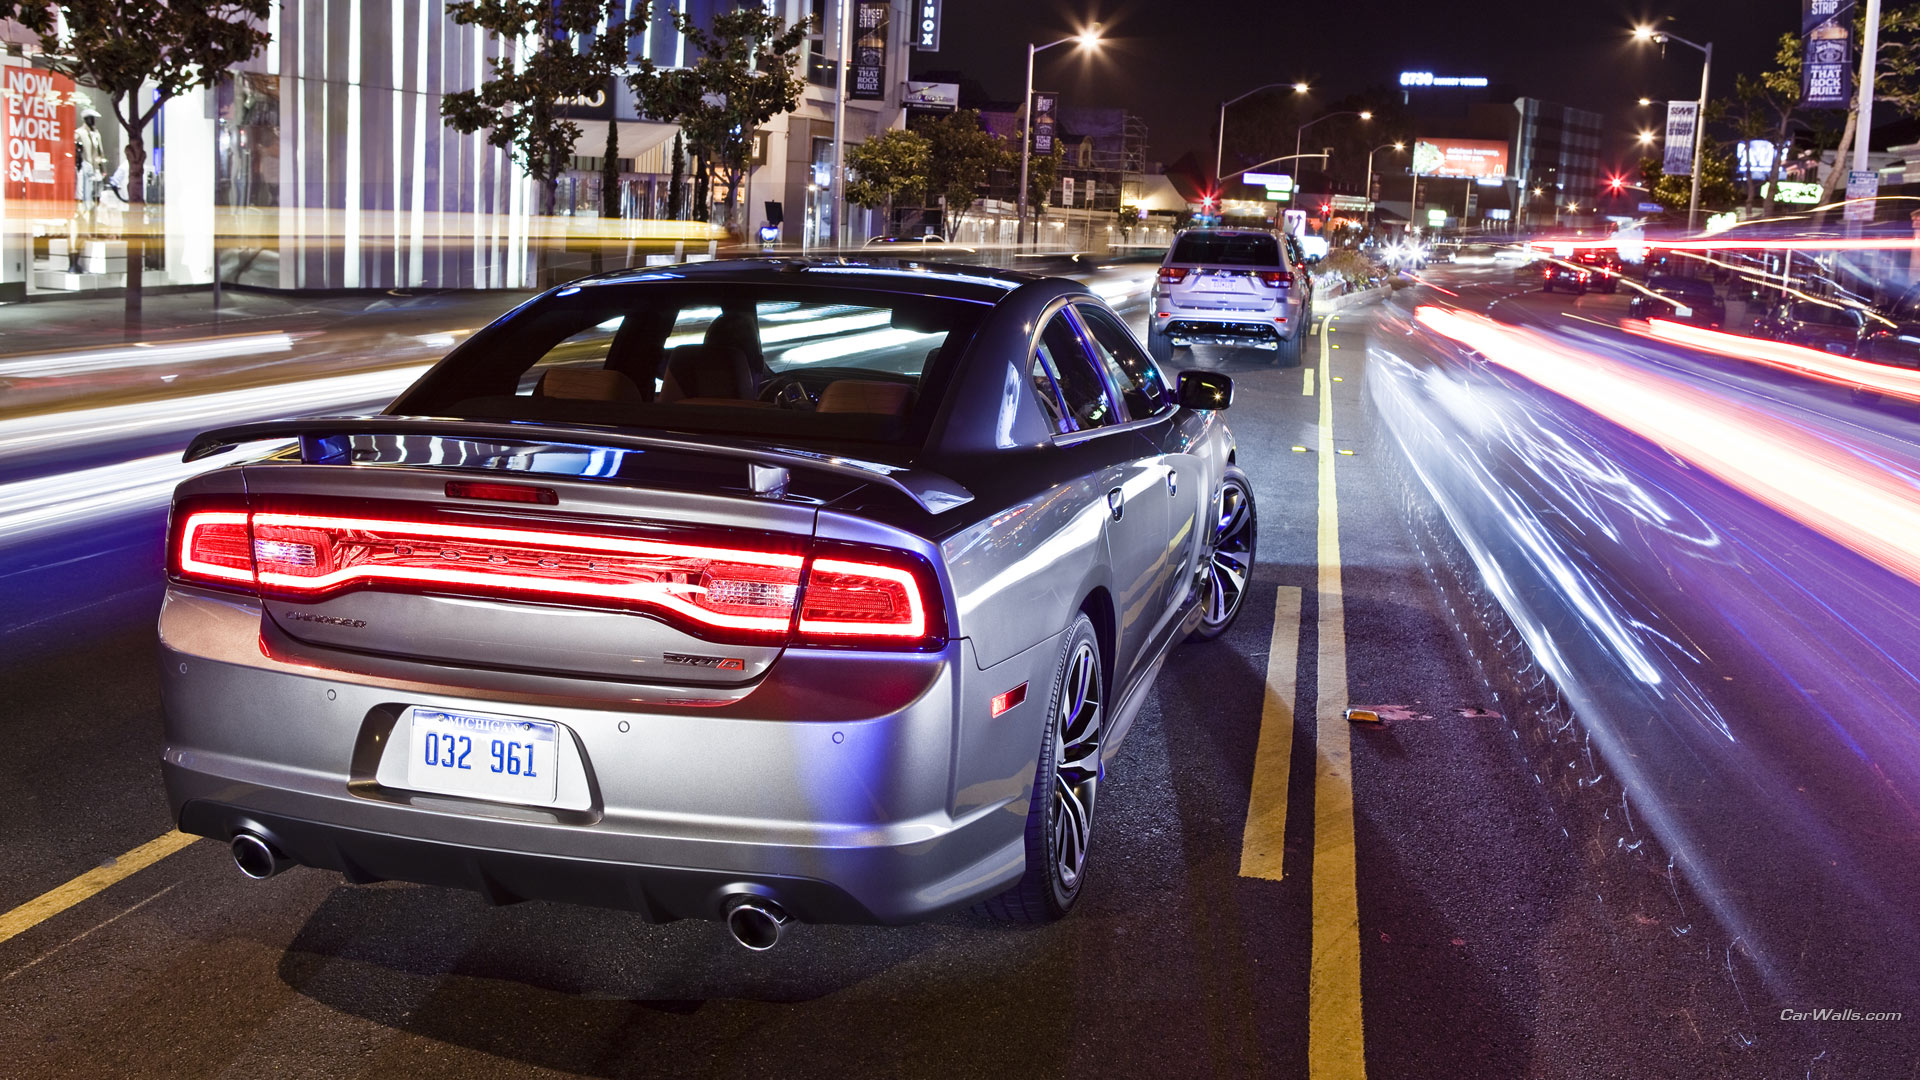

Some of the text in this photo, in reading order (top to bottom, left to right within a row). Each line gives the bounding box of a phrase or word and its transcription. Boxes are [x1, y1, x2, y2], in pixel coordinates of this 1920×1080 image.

[1811, 1, 1838, 15] STRIP
[9, 71, 54, 97] NOW
[1810, 79, 1841, 87] ROCK
[1811, 70, 1842, 79] THAT
[9, 95, 57, 119] EVEN
[9, 116, 60, 141] MORE
[9, 138, 37, 161] ON
[10, 160, 55, 184] SA
[394, 543, 610, 573] DODGE
[448, 715, 521, 733] MICHIGAN
[425, 731, 538, 778] 032 961
